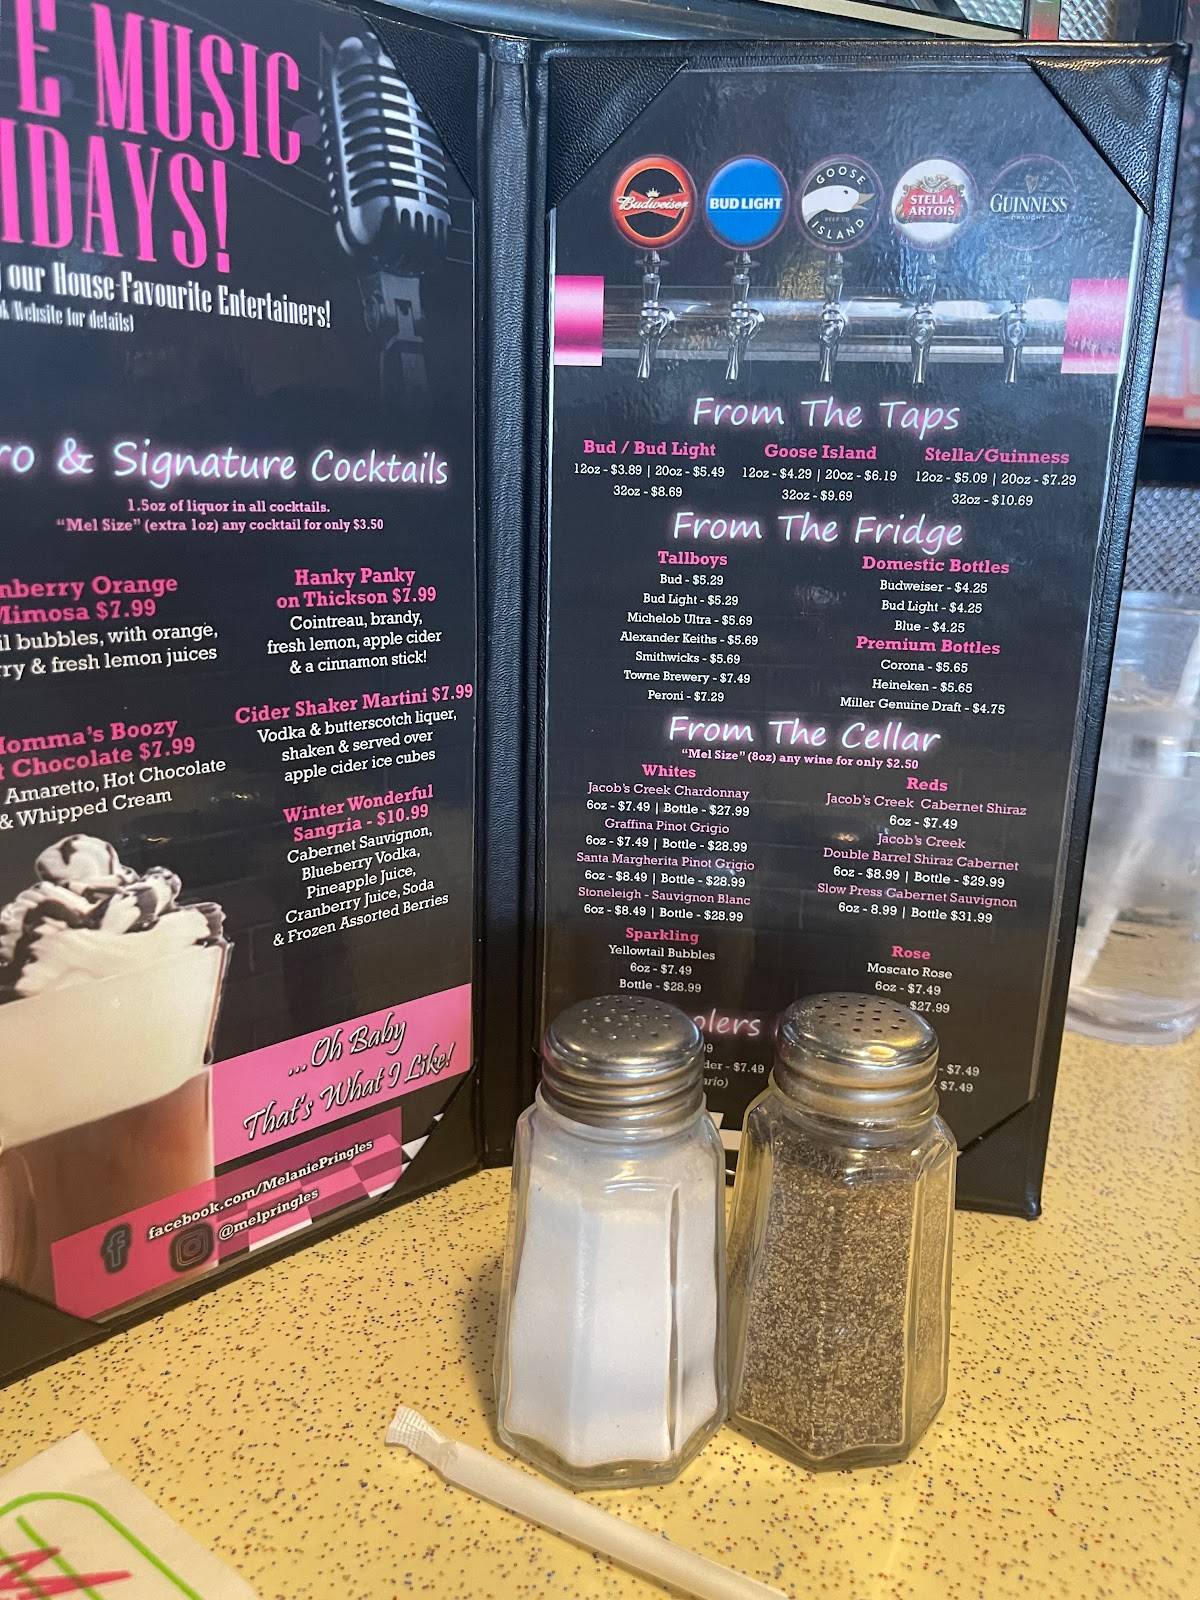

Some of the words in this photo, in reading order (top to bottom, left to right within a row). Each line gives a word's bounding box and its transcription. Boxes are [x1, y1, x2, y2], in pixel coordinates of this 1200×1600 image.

[92, 3, 301, 166] MUSIC
[816, 166, 867, 185] GOOSE
[616, 195, 690, 211] Budweiser
[709, 197, 739, 210] BUD
[741, 197, 782, 210] LIGHT
[910, 194, 955, 206] STELLA
[990, 193, 1068, 214] GUINNESS
[908, 204, 955, 217] ARTOIS
[811, 217, 866, 240] ISLAND
[7, 263, 46, 293] our
[217, 285, 331, 329] Entertainers!
[66, 307, 85, 328] for
[694, 397, 784, 426] From
[801, 396, 863, 428] The
[880, 401, 960, 440] Taps
[584, 440, 616, 454] Bud
[634, 441, 667, 455] Bud
[671, 442, 716, 460] Light
[764, 444, 817, 458] Goose
[821, 445, 877, 460] Island
[57, 437, 94, 474] &
[114, 439, 297, 489] Signature
[311, 449, 448, 485] Cocktails
[574, 463, 600, 474] 12oz
[611, 464, 642, 475] $3.89
[655, 465, 682, 476] 20oz
[693, 466, 725, 477] $5.49
[614, 485, 640, 496] 32oz
[651, 487, 682, 497] $8.69
[128, 499, 166, 513] 1.5oz
[170, 500, 184, 512] of
[187, 500, 229, 515] liquor
[232, 500, 246, 512] in
[249, 500, 267, 512] all
[270, 500, 330, 513] cocktails.
[673, 512, 762, 540] From
[778, 511, 838, 543] The
[854, 513, 963, 555] Fridge
[658, 551, 728, 568] Tallboys
[862, 556, 944, 572] Domestic
[949, 559, 1010, 574] Bottles
[92, 575, 178, 596] Orange
[295, 569, 355, 588] Hanky
[360, 568, 415, 586] Panky
[660, 574, 682, 585] Bud
[692, 575, 724, 585] $5.29
[880, 580, 944, 592] Budweiser
[954, 582, 988, 593] $4.25
[277, 594, 300, 609] on
[304, 590, 387, 607] Thickson
[392, 587, 437, 604] $7.99
[290, 613, 367, 630] Cointreau,
[370, 612, 423, 627] brandy,
[627, 612, 681, 624] Michelob
[684, 614, 711, 625] Ultra
[722, 615, 752, 626] $5.69
[895, 620, 921, 631] Blue
[932, 622, 965, 633] $4.25
[267, 638, 306, 654] fresh
[310, 634, 360, 651] lemon,
[362, 633, 403, 651] apple
[406, 629, 442, 644] cider
[620, 632, 680, 643] Alexander
[682, 633, 717, 644] Keiths
[727, 635, 758, 646] $5.69
[856, 636, 936, 652] Premium
[941, 640, 1001, 655] Bottles
[635, 651, 700, 663] Smithwicks
[710, 653, 741, 664] $5.69
[880, 660, 924, 671] Corona
[936, 661, 968, 673] $5.65
[624, 670, 660, 681] Towne
[663, 671, 709, 684] Brewery
[720, 673, 750, 684] $7.49
[872, 679, 929, 691] Heineken
[940, 682, 972, 693] $5.65
[234, 704, 291, 724] Cider
[295, 697, 357, 716] Shaker
[362, 689, 428, 710] Martini
[432, 683, 473, 701] $7.99
[648, 690, 684, 701] Peroni
[694, 691, 724, 702] $7.29
[840, 697, 875, 708] Miller
[878, 699, 929, 711] Genuine
[931, 701, 961, 712] Draft
[972, 703, 1005, 714] $4.75
[110, 720, 178, 742] Boozy
[257, 725, 307, 743] Vodka
[311, 723, 321, 736] &
[324, 710, 412, 734] butterscotch
[669, 716, 754, 742] From
[768, 718, 826, 746] The
[842, 721, 941, 752] Cellar
[642, 764, 696, 778] Whites
[7, 776, 99, 804] Amaretto,
[104, 772, 135, 789] Hot
[139, 757, 226, 783] Chocolate
[907, 777, 948, 792] Reds
[633, 784, 671, 795] Creek
[674, 786, 750, 800] Chardonnay
[283, 799, 343, 824] Winter
[346, 785, 434, 812] Wonderful
[587, 800, 607, 810] 6oz
[618, 801, 650, 812] $7.49
[664, 803, 698, 814] Bottle
[709, 804, 750, 816] $27.99
[294, 821, 363, 843] Sangria
[377, 804, 429, 827] $10.99
[605, 818, 653, 830] Graffina
[656, 821, 686, 832] Pinot
[690, 822, 730, 835] Grigio
[287, 841, 356, 864] Cabernet
[359, 826, 433, 850] Sauvignon,
[823, 848, 869, 860] Double
[872, 851, 911, 863] Barrel
[914, 854, 953, 866] Shiraz
[957, 857, 1019, 871] Cabernet
[578, 887, 641, 900] Stoneleigh
[652, 890, 714, 903] Sauvignon
[717, 894, 751, 906] Blanc
[817, 883, 846, 894] Slow
[849, 885, 882, 897] Press
[886, 888, 947, 902] Cabernet
[950, 893, 1017, 908] Sauvignon
[273, 933, 284, 947] &
[288, 920, 336, 944] Frozen
[339, 904, 400, 931] Assorted
[403, 893, 449, 916] Berries
[625, 927, 700, 945] Sparkling
[608, 945, 664, 957] Yellowtail
[668, 948, 716, 960] Bubbles
[892, 946, 931, 960] Rose
[867, 963, 919, 976] Moscato
[922, 967, 952, 979] Rose
[349, 1012, 407, 1056] Baby
[321, 1072, 385, 1111] What
[404, 1042, 456, 1084] Like!
[147, 1138, 373, 1240] facebook.com/MelaniePringles
[218, 1189, 319, 1241] @melpringles
